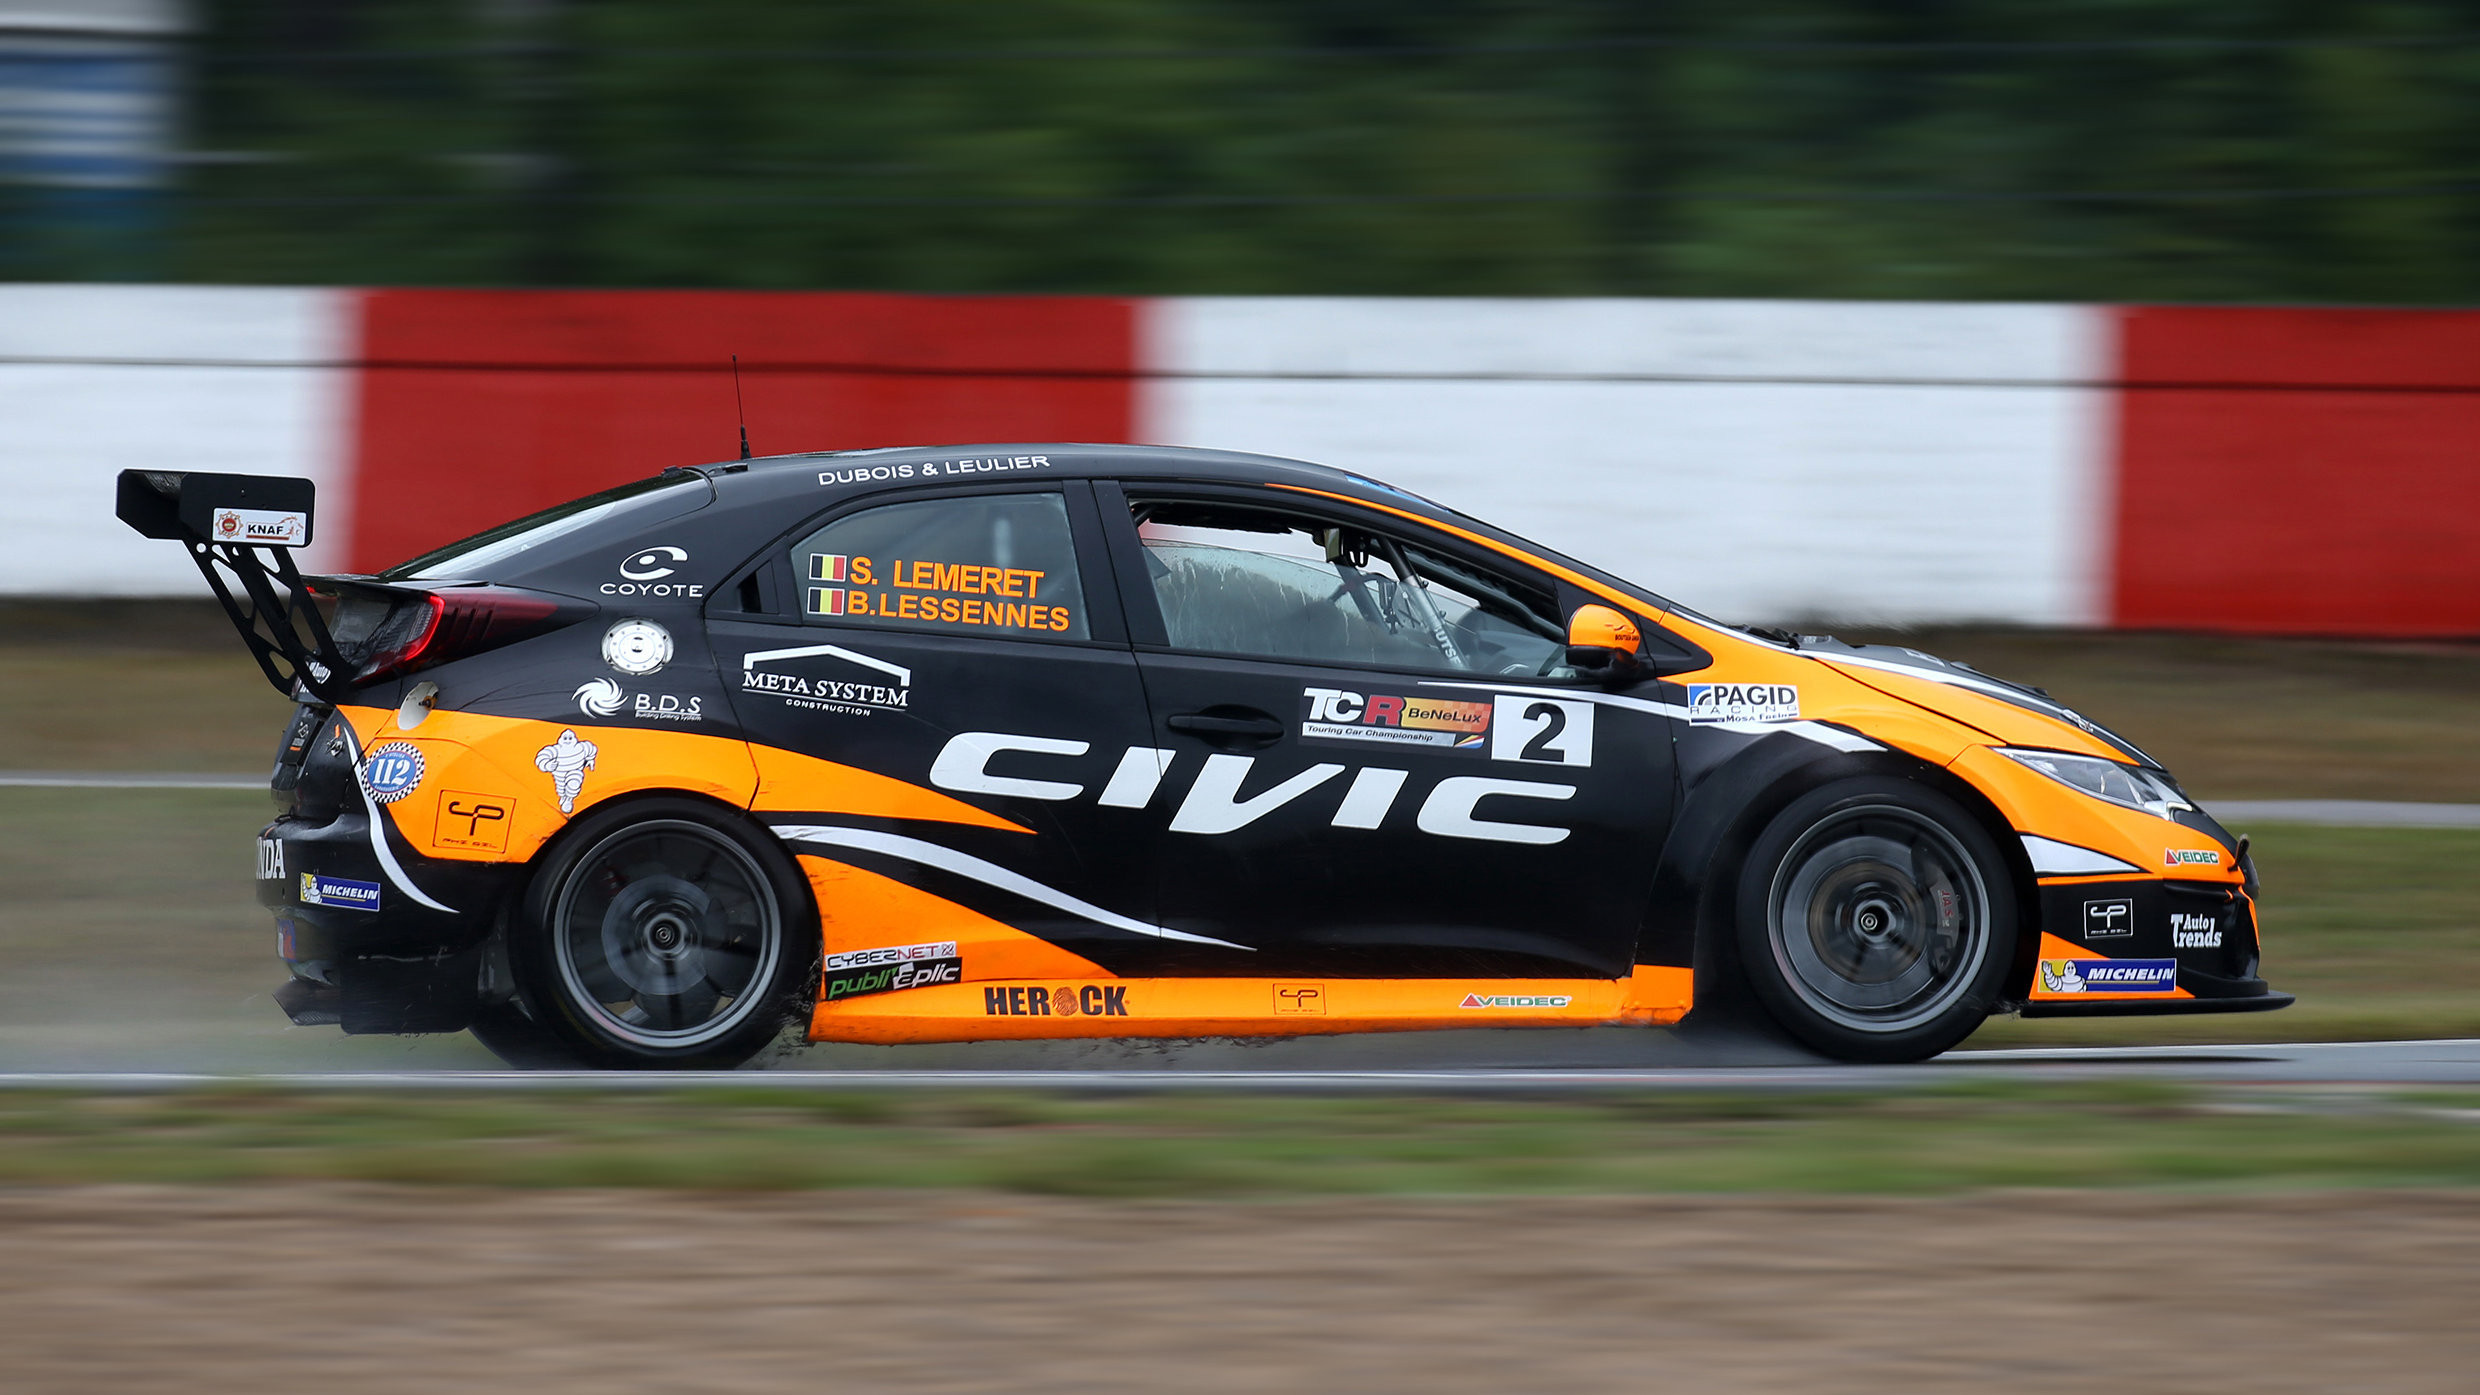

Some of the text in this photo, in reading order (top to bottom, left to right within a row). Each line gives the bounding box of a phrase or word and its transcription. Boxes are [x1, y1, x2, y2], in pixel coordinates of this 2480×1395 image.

[817, 455, 1051, 486] DUBOIS & LEULIER
[247, 524, 284, 535] KNAF
[850, 556, 1044, 599] S. LEMERET
[600, 583, 703, 598] COYOTE
[742, 671, 909, 707] META SYSTEM
[1714, 685, 1796, 706] PAGID
[634, 693, 702, 714] B.D.S
[785, 698, 871, 717] CONSTRUCTION
[1303, 687, 1482, 726] TCR BeNeLux
[1690, 705, 1797, 715] RACING
[1307, 724, 1433, 743] Touring Car Championship
[1519, 702, 1567, 763] 2
[373, 758, 411, 786] 112
[929, 731, 1577, 845] CIVIC
[2171, 850, 2219, 864] VEIDEC
[321, 883, 379, 901] MICHELIN
[2170, 913, 2223, 948] Trends
[2183, 913, 2209, 930] Auto
[828, 945, 939, 969] CYBERNET
[2087, 967, 2175, 981] MICHELIN
[1476, 996, 1567, 1006] VEIDEC
